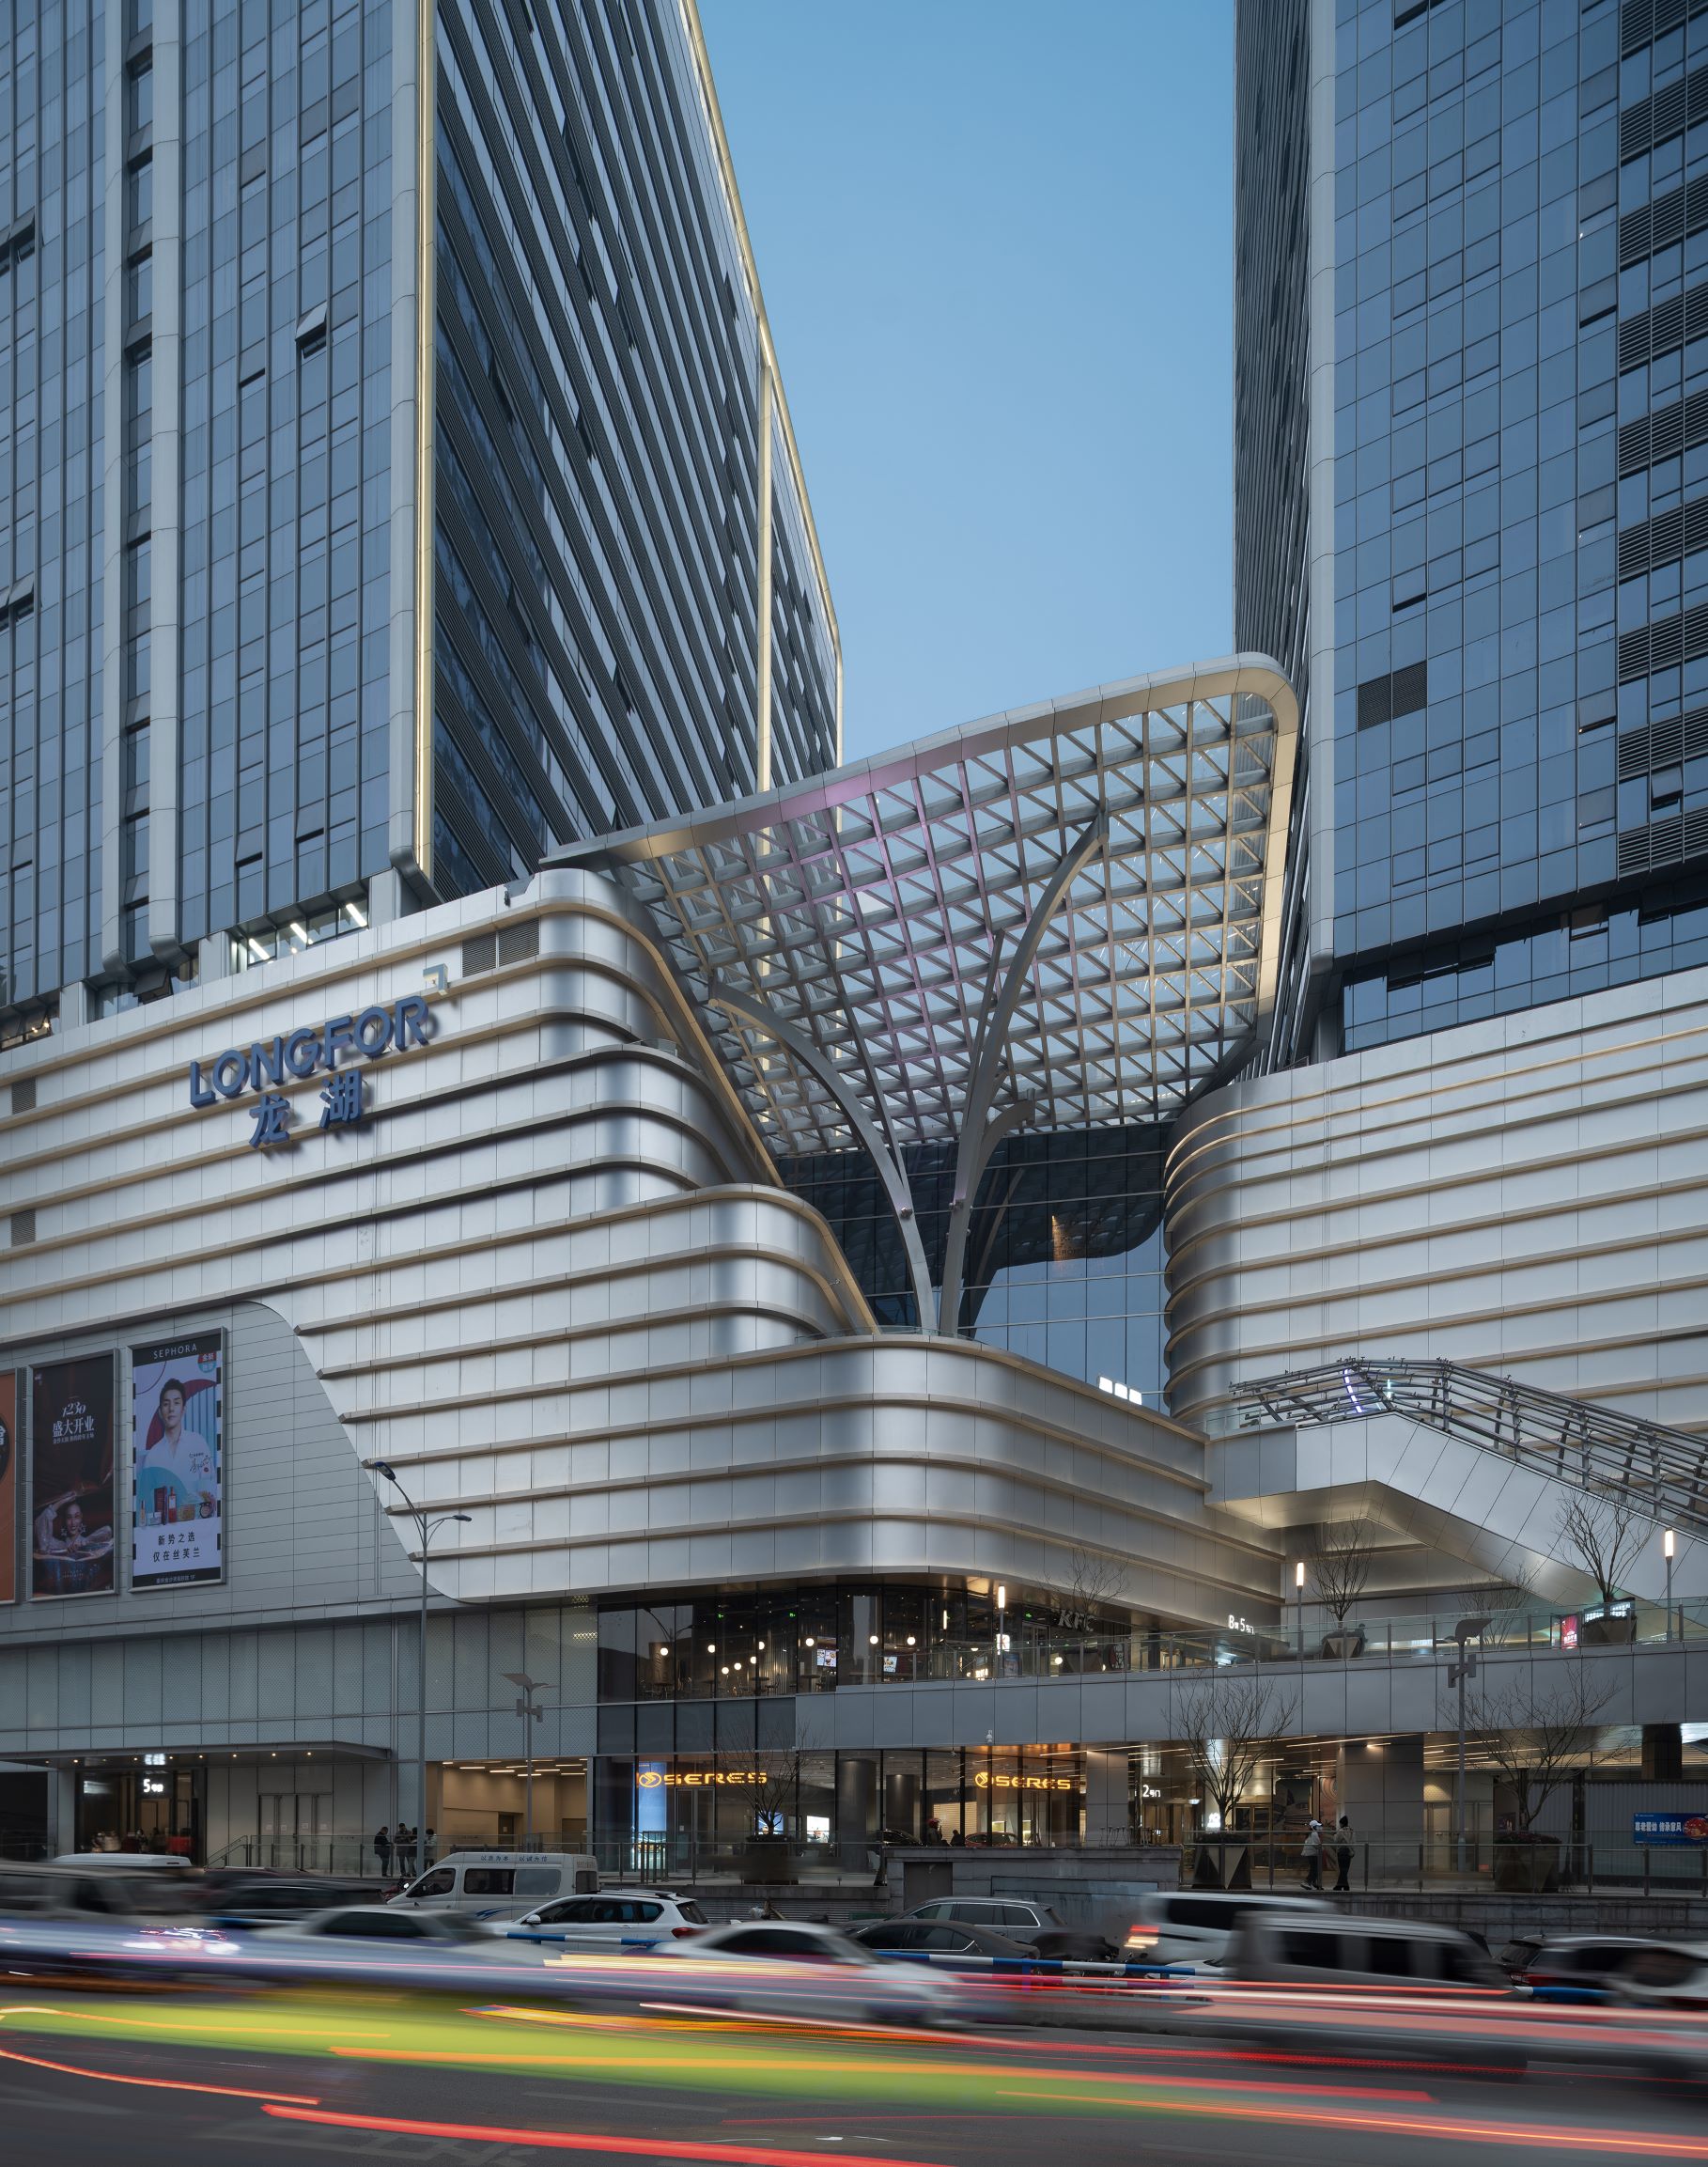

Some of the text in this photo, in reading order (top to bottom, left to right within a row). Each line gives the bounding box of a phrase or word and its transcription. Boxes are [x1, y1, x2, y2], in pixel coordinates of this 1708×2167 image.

[190, 995, 429, 1108] LONGFOR
[249, 1069, 363, 1148] 龙湖
[153, 1343, 197, 1360] SEPHORA
[53, 1415, 95, 1438] 盛大开业
[158, 1531, 195, 1546] 新势之选
[153, 1547, 200, 1563] 仅在丝芙兰
[1058, 1609, 1096, 1632] KFC
[663, 1772, 768, 1785] SERES
[995, 1775, 1071, 1789] SERES
